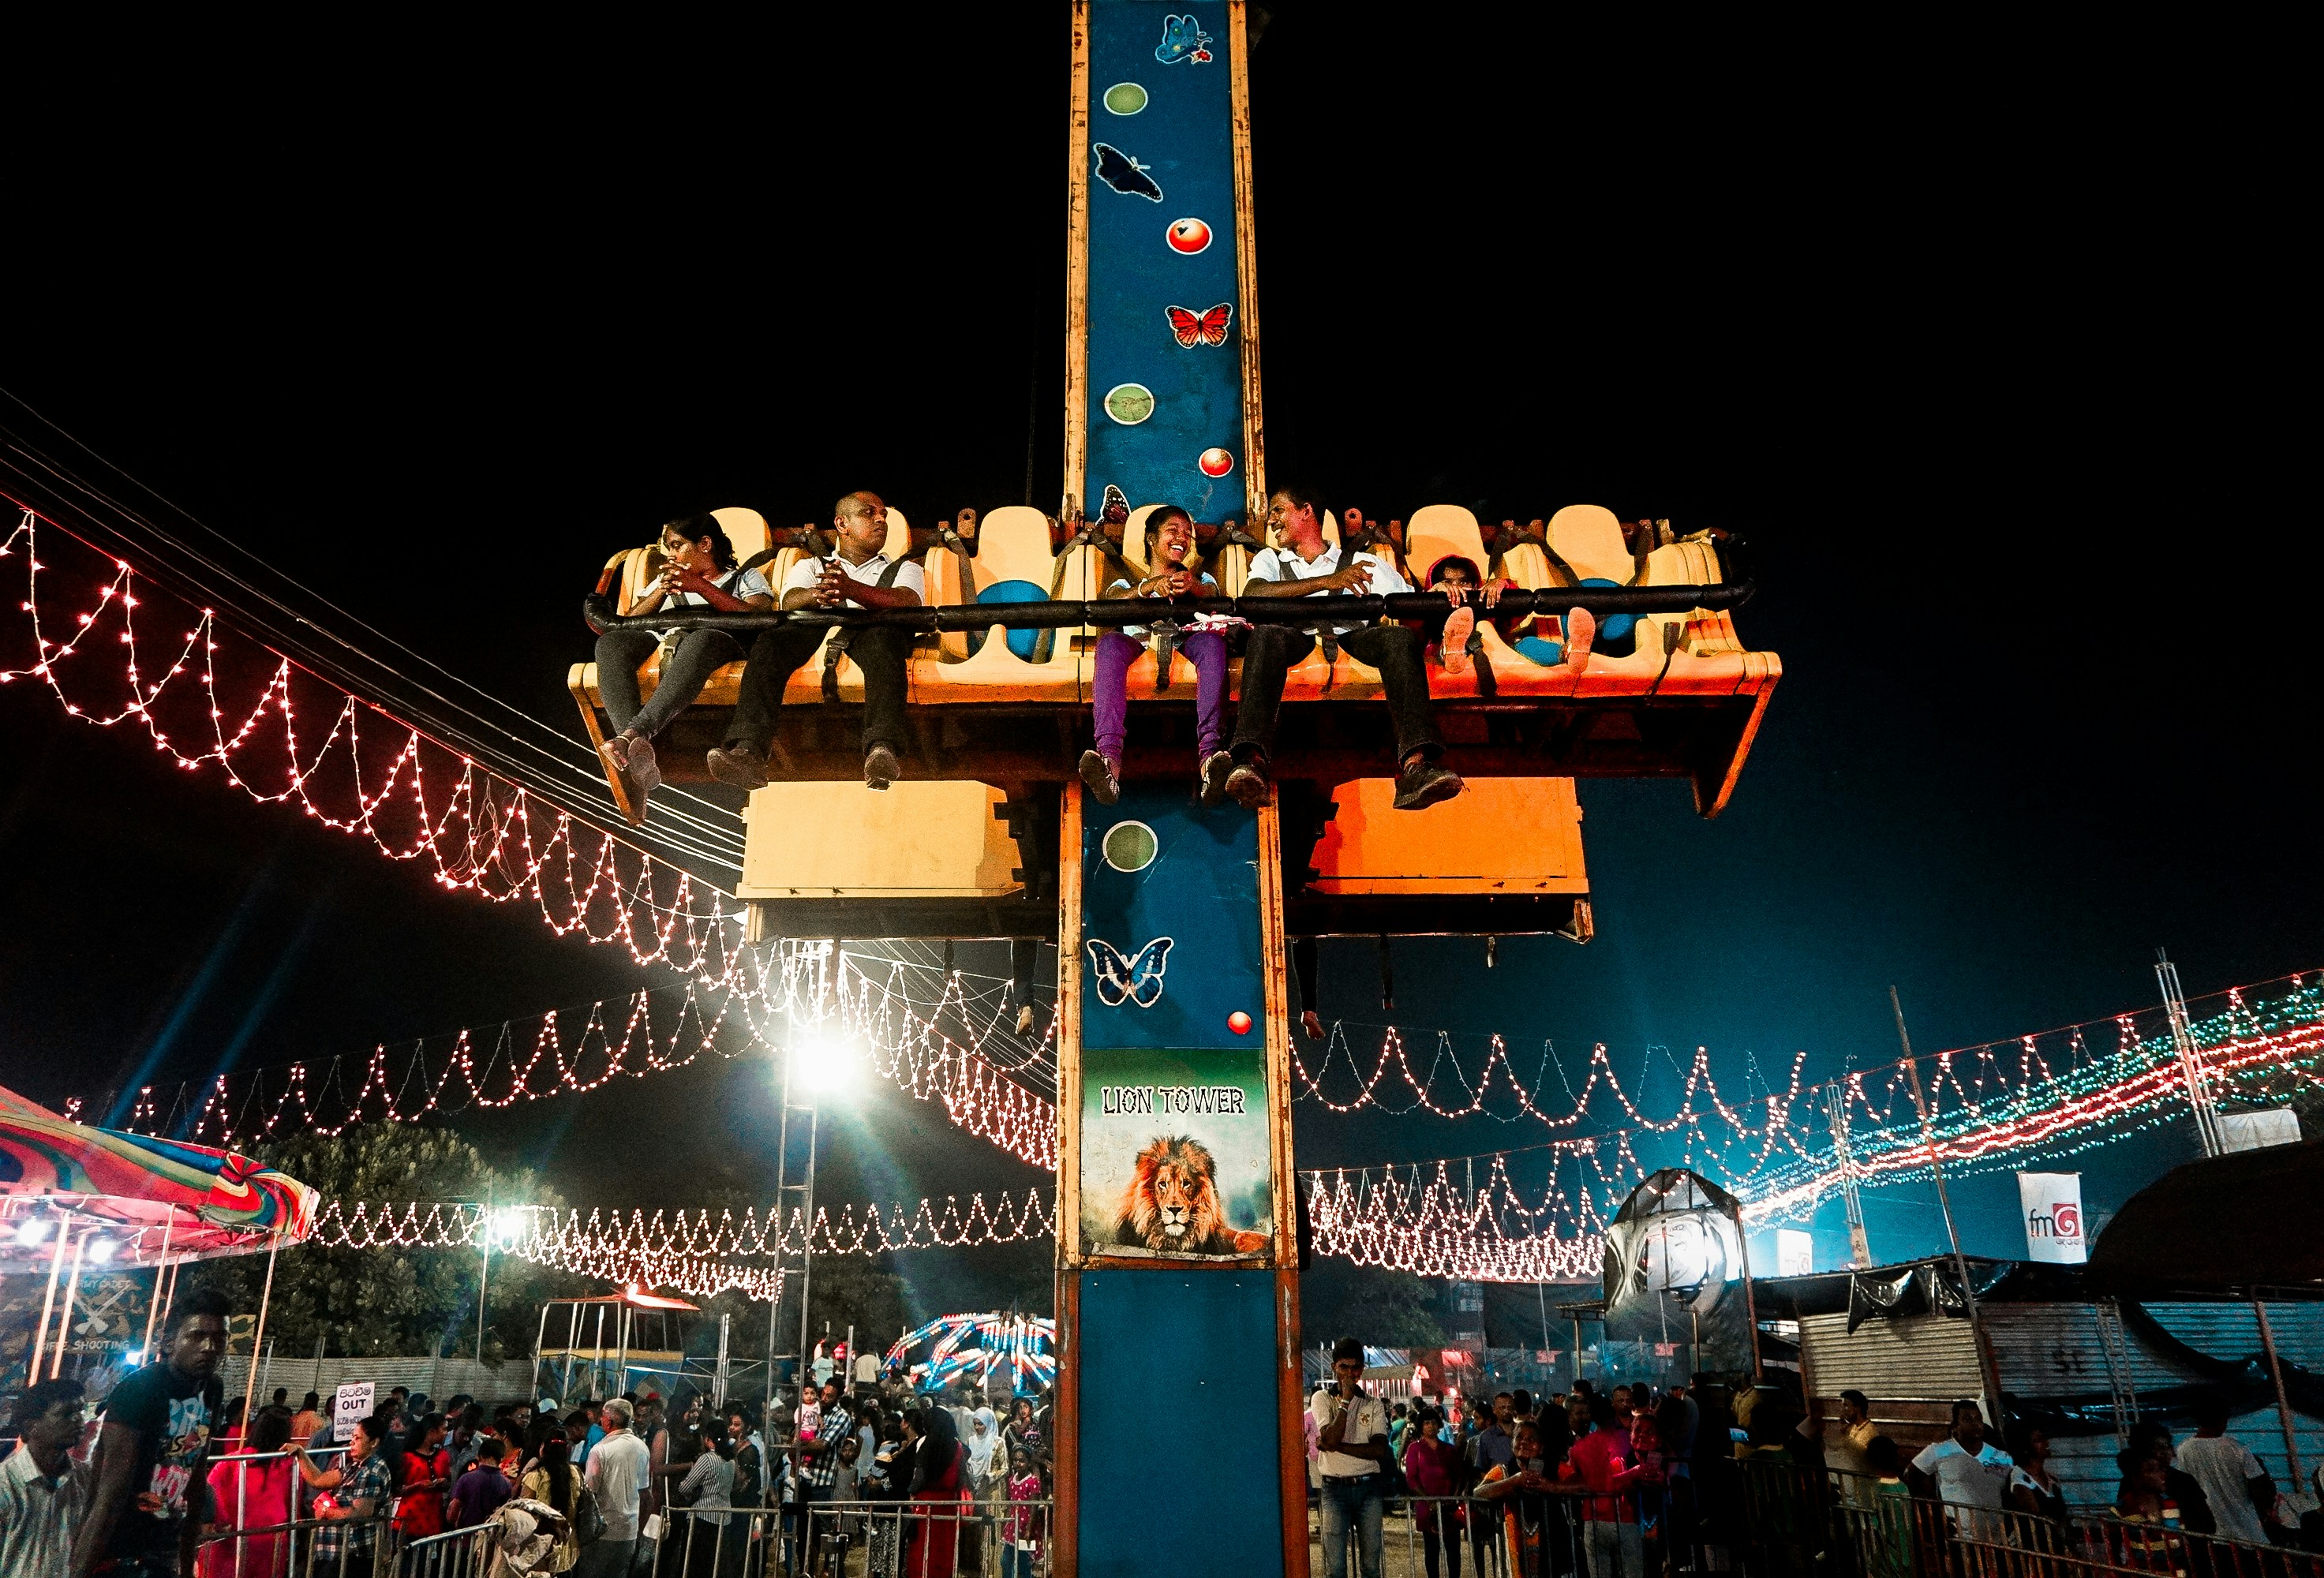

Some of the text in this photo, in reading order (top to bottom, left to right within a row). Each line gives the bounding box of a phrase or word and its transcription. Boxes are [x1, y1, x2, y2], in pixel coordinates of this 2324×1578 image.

[1101, 1086, 1245, 1115] LION TOWER
[73, 1341, 130, 1351] SHOOTING
[342, 1399, 366, 1410] OUT
